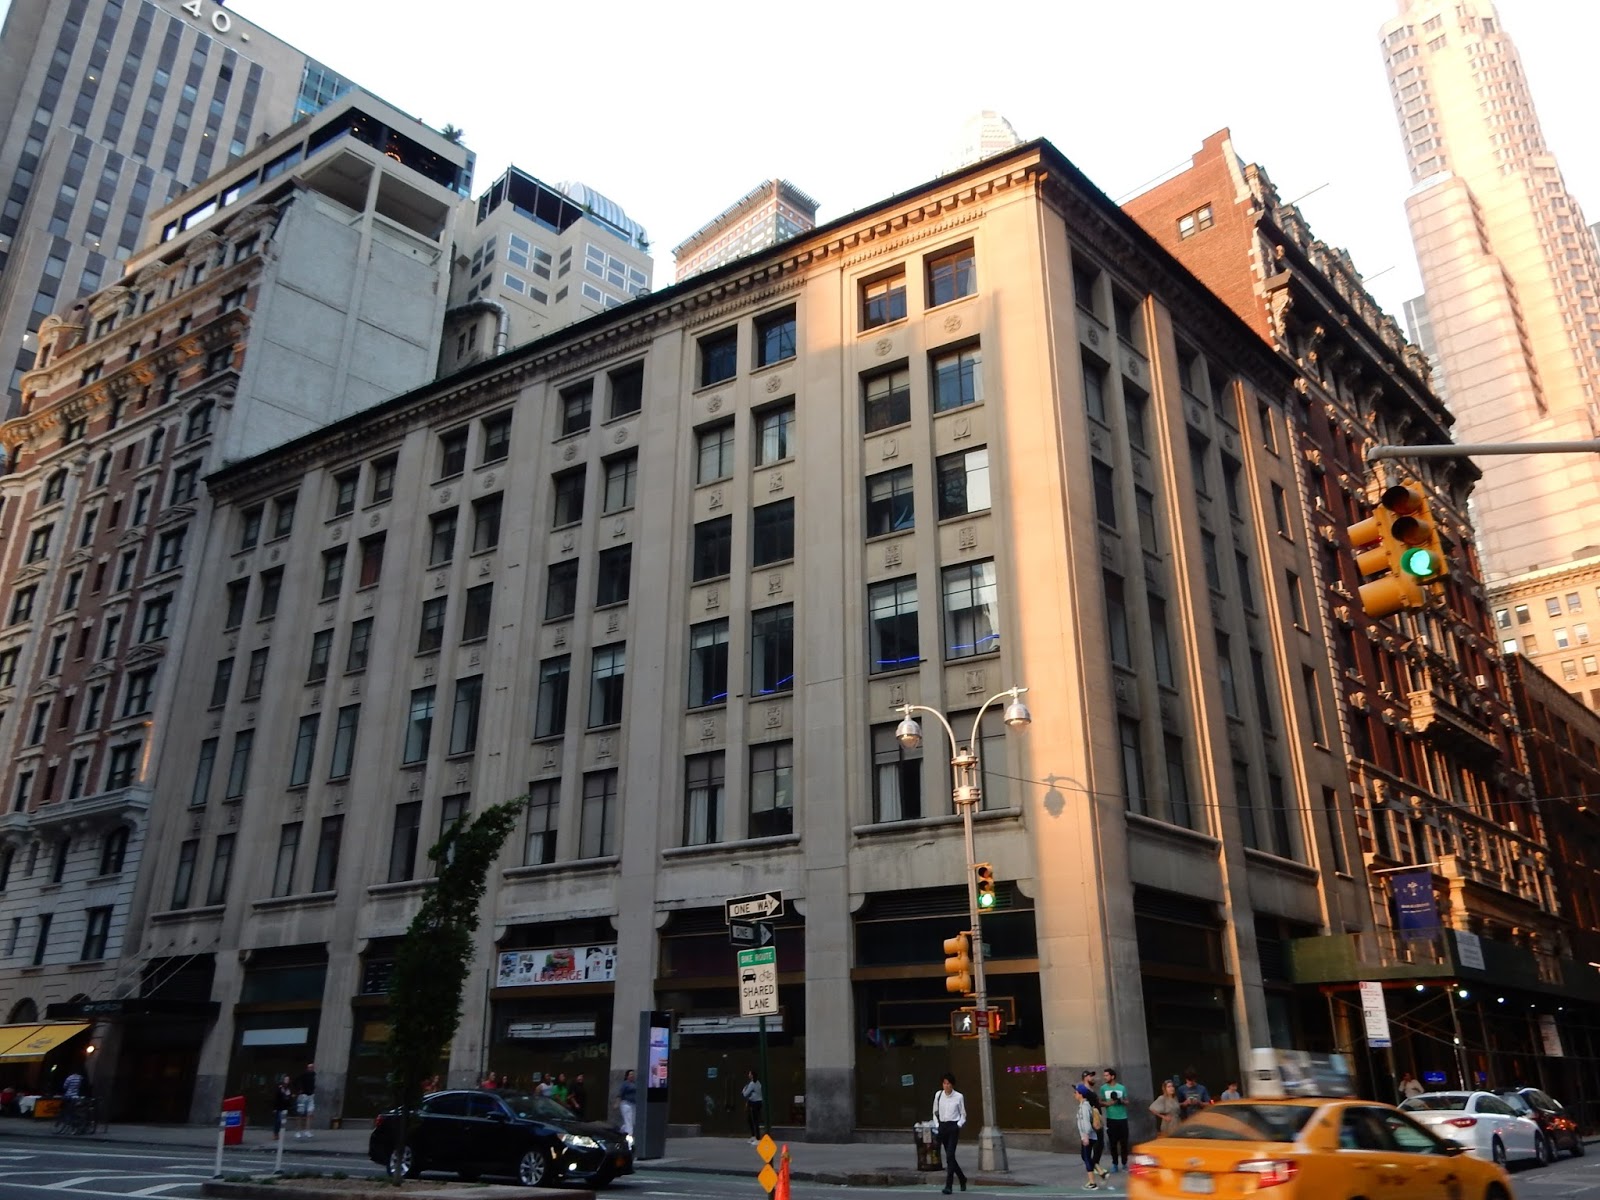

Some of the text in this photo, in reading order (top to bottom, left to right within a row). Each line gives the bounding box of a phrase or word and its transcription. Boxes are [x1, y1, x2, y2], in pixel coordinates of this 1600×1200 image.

[734, 900, 774, 915] ONE WAY
[736, 927, 748, 938] ONE
[741, 952, 773, 963] BIKE ROUTE
[534, 970, 583, 982] LUGGAGE
[743, 985, 774, 997] SHARED
[749, 998, 769, 1010] LANE
